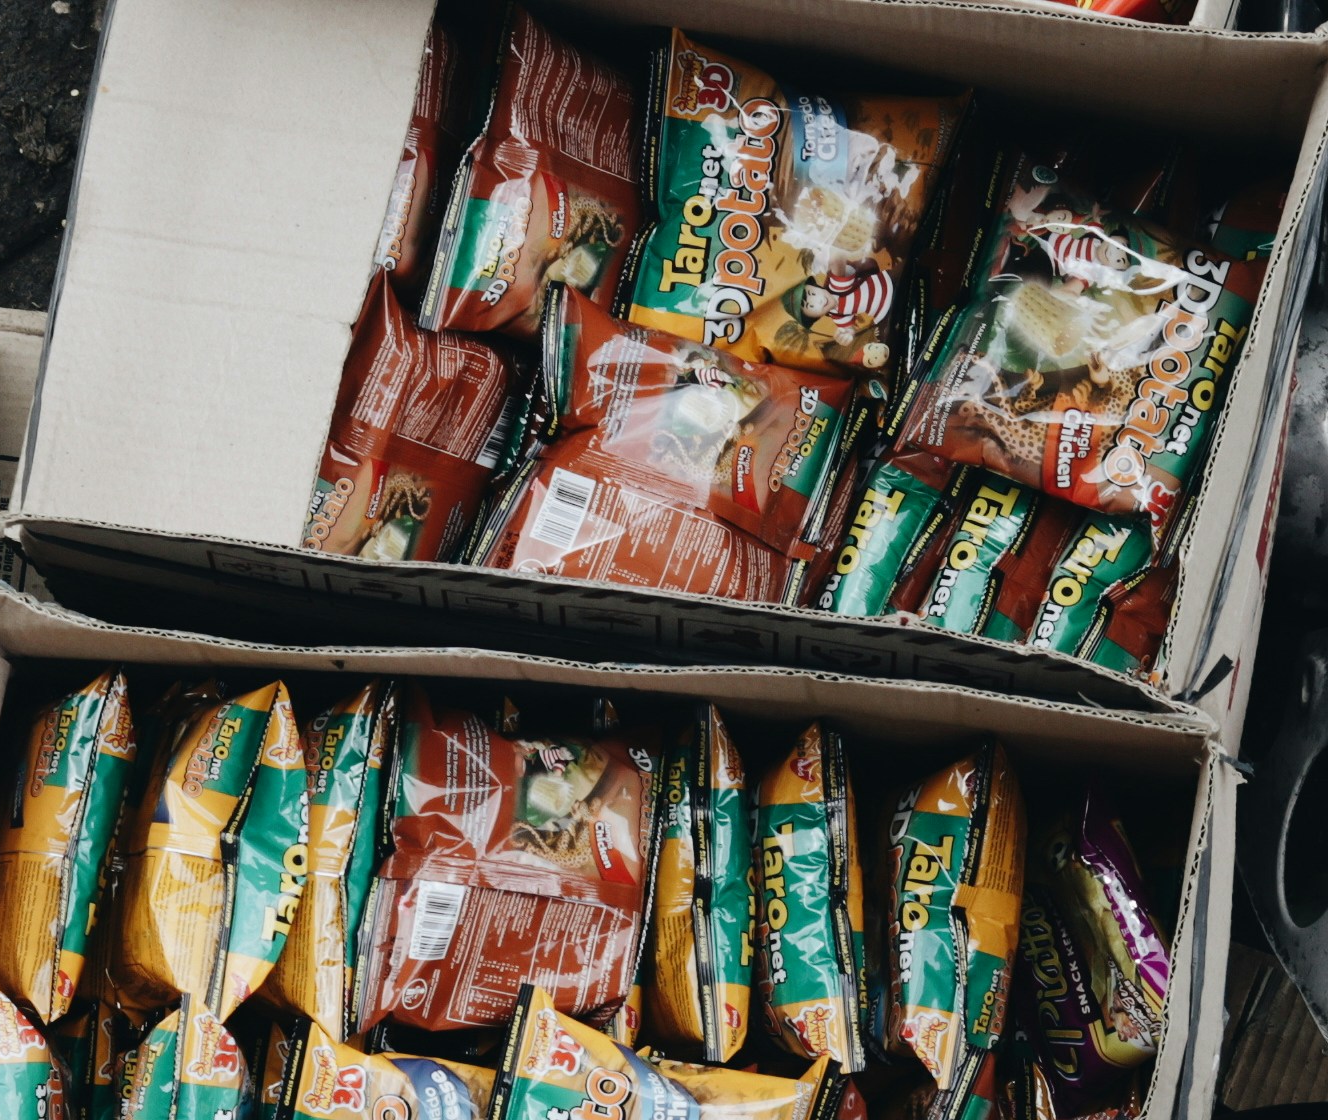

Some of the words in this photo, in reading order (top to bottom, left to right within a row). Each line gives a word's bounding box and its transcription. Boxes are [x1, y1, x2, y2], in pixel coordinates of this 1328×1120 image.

[800, 96, 818, 161] Tornado
[553, 191, 565, 240] Chicken
[658, 194, 714, 294] Taro
[699, 144, 724, 199] net
[712, 97, 784, 297] potato
[481, 279, 508, 306] 3D
[1175, 250, 1232, 315] 3D
[702, 286, 754, 347] 3D
[1190, 317, 1249, 413] Taro
[799, 386, 819, 414] 3D
[1103, 300, 1211, 487] potato
[768, 410, 811, 493] potato
[800, 417, 829, 457] Taro
[1057, 408, 1083, 489] Chicken
[1077, 411, 1098, 460] Jungle
[1164, 407, 1201, 457] net
[736, 446, 749, 492] Chicken
[787, 454, 806, 478] net
[311, 490, 326, 516] net
[948, 485, 1021, 571] Taro
[837, 487, 906, 575] Taro
[1052, 524, 1132, 607] Taro
[819, 573, 843, 611] ne
[928, 567, 960, 618] net
[54, 703, 79, 751] Taro
[213, 716, 243, 760] Taro
[315, 725, 345, 772] Taro
[49, 748, 61, 775] net
[182, 727, 221, 799] potato
[208, 757, 220, 782] net
[314, 770, 325, 794] net
[628, 747, 653, 772] 3D
[666, 756, 686, 804] Taro
[666, 799, 679, 829] net
[593, 821, 613, 871] Chicken
[260, 843, 309, 949] Taro
[763, 822, 794, 934] Taro
[900, 833, 954, 936] Taro
[768, 929, 789, 986] net
[898, 930, 915, 987] net
[971, 994, 998, 1036] Taro
[990, 968, 1003, 994] net
[1069, 959, 1091, 1015] SNACK
[333, 1067, 364, 1109] 3D
